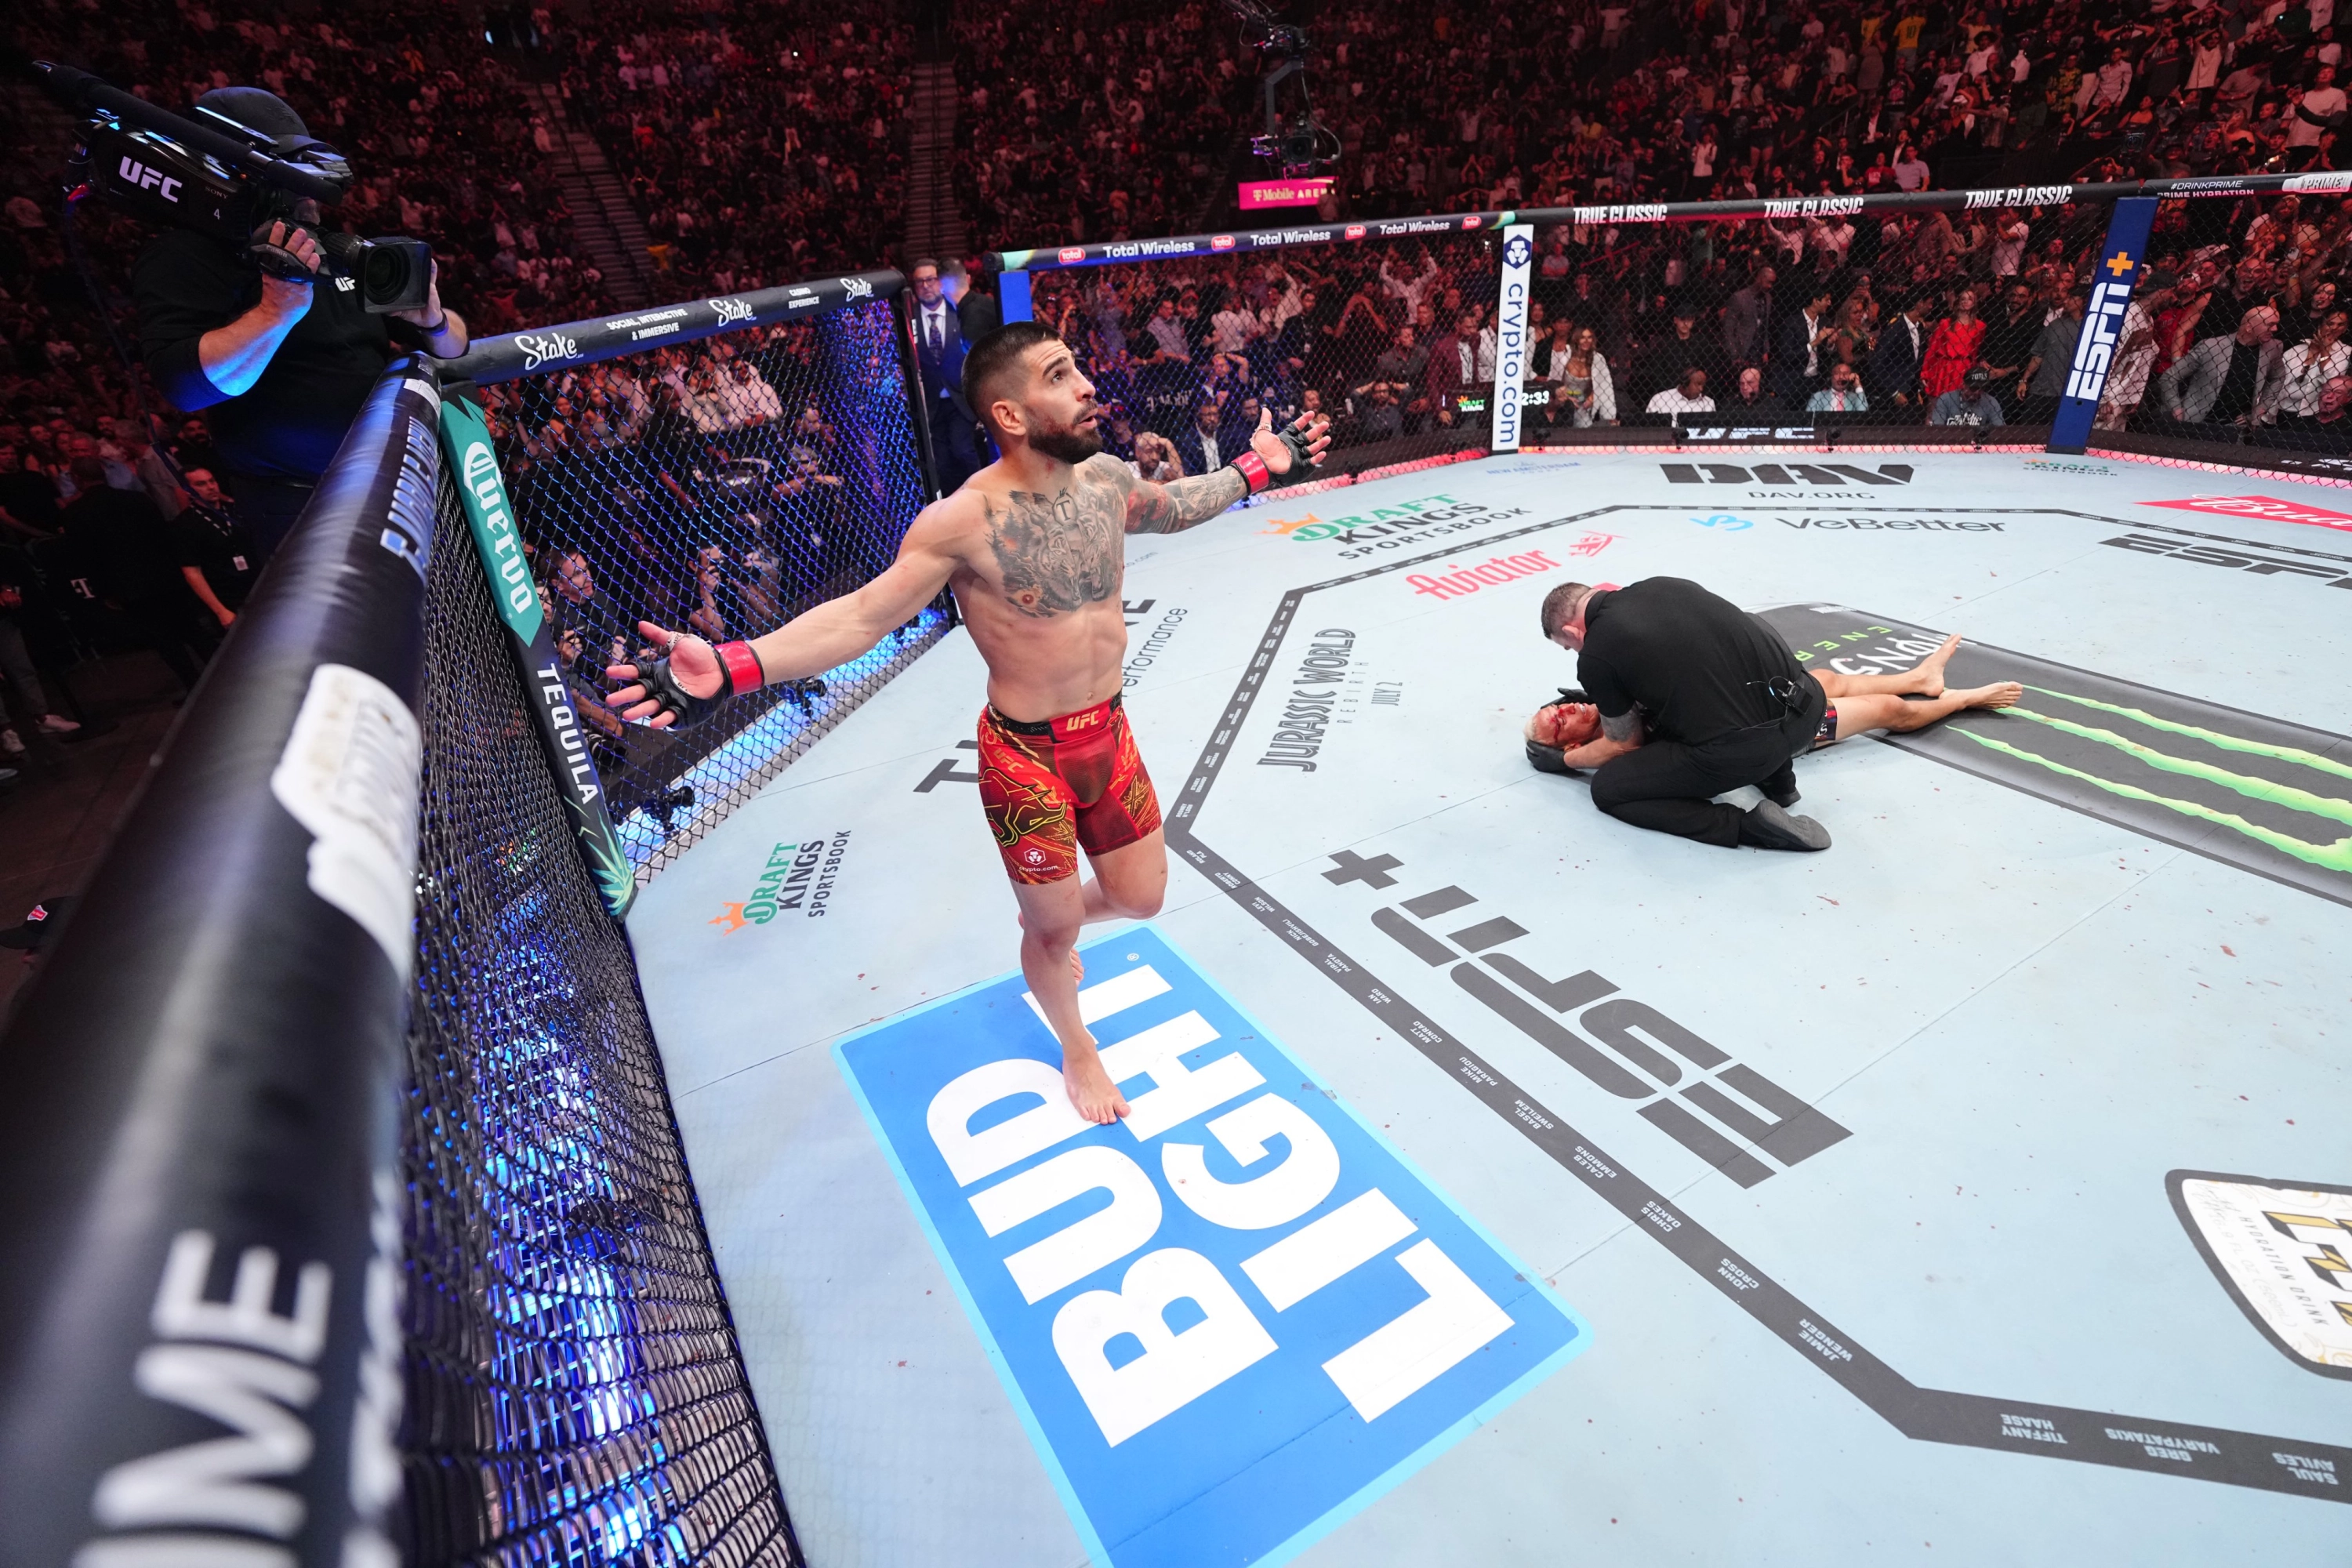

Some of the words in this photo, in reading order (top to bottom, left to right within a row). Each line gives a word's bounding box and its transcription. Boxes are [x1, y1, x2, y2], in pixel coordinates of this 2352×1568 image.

[119, 156, 183, 203] UFC
[2170, 180, 2243, 191] #DRINKPRIME
[2306, 176, 2343, 191] PRIME
[204, 185, 229, 200] SONY
[1964, 190, 2005, 209] TRUE
[2005, 185, 2073, 207] CLASSIC
[213, 209, 221, 220] 4
[1573, 206, 1608, 225] TRUE
[1609, 205, 1668, 223] CLASSIC
[1764, 201, 1801, 219] TRUE
[1800, 196, 1864, 218] CLASSIC
[1250, 232, 1282, 246] Total
[1283, 230, 1330, 245] Wireless
[1379, 223, 1407, 235] Total
[1408, 221, 1450, 234] Wireless
[266, 244, 288, 258] Canon
[1103, 243, 1139, 258] Total
[1140, 241, 1195, 255] Wireless
[1214, 236, 1233, 249] total
[1061, 249, 1083, 261] total
[335, 276, 355, 292] UF
[840, 278, 872, 302] Stake
[709, 299, 753, 327] Stake
[788, 296, 819, 309] EXPERIENCE
[606, 318, 640, 331] SOCIAL,
[639, 308, 688, 325] INTERACTIVE
[2066, 252, 2134, 401] ESPN+
[632, 331, 638, 341] &
[639, 322, 680, 339] IMMERSIVE
[514, 332, 577, 371] Stake
[1500, 283, 1523, 443] crypto.com
[1659, 464, 1914, 485] DAV
[463, 441, 533, 614] Cuervo
[1291, 493, 1465, 542] DRAFT
[1333, 503, 1488, 545] KINGS
[1774, 518, 2005, 532] VeBetter
[1338, 507, 1533, 560] SPORTSBOOK
[2097, 533, 2352, 590] ESP
[1406, 550, 1562, 601] Aviator
[1121, 608, 1188, 697] erformance
[1293, 629, 1356, 684] WORLD
[1066, 710, 1099, 731] UFC
[1256, 690, 1337, 772] JURASSIC
[537, 663, 598, 804] TEQUILA
[993, 747, 1024, 773] UFC
[742, 842, 798, 924] DRAFT
[775, 840, 825, 910] KINGS
[808, 829, 851, 917] SPORTSBOOK
[1214, 873, 1237, 889] ROBERTO
[1252, 902, 1265, 912] LEVI
[1255, 897, 1275, 913] WILSON
[1287, 930, 1301, 941] NICK
[1324, 958, 1342, 973] VIRAL
[1328, 953, 1352, 972] PANDYA
[1368, 994, 1381, 1004] IAN
[1371, 988, 1391, 1004] WARD
[1319, 849, 1854, 1190] ESPN+
[1410, 1028, 1432, 1044] MATT
[1413, 1021, 1443, 1044] CONRAD
[1459, 1056, 1498, 1087] PARAGIOU
[1461, 1066, 1483, 1083] MIKE
[1514, 1107, 1541, 1130] BASEL
[1515, 1099, 1554, 1130] SWEILEM
[1573, 1154, 1604, 1178] CALEB
[1574, 1145, 1617, 1178] EMMONS
[1022, 964, 1516, 1424] LIGHT
[1641, 1207, 1673, 1232] CHRIS
[1646, 1200, 1682, 1229] OAKES
[926, 1058, 1279, 1448] BUD
[1717, 1267, 1749, 1290] JOHN
[1721, 1258, 1759, 1289] CROSS
[2240, 1216, 2296, 1281] HYDRATION
[2289, 1287, 2329, 1327] DRINK
[1798, 1319, 1853, 1362] WENGER
[1798, 1330, 1840, 1361] JAMIE
[2000, 1413, 2054, 1432] HAASE
[2002, 1425, 2068, 1444] TIFFANY
[2104, 1428, 2220, 1455] VARYPATAKIS
[2144, 1445, 2193, 1462] GREG
[2272, 1452, 2336, 1472] AVILES
[2287, 1466, 2339, 1486] SAUL
